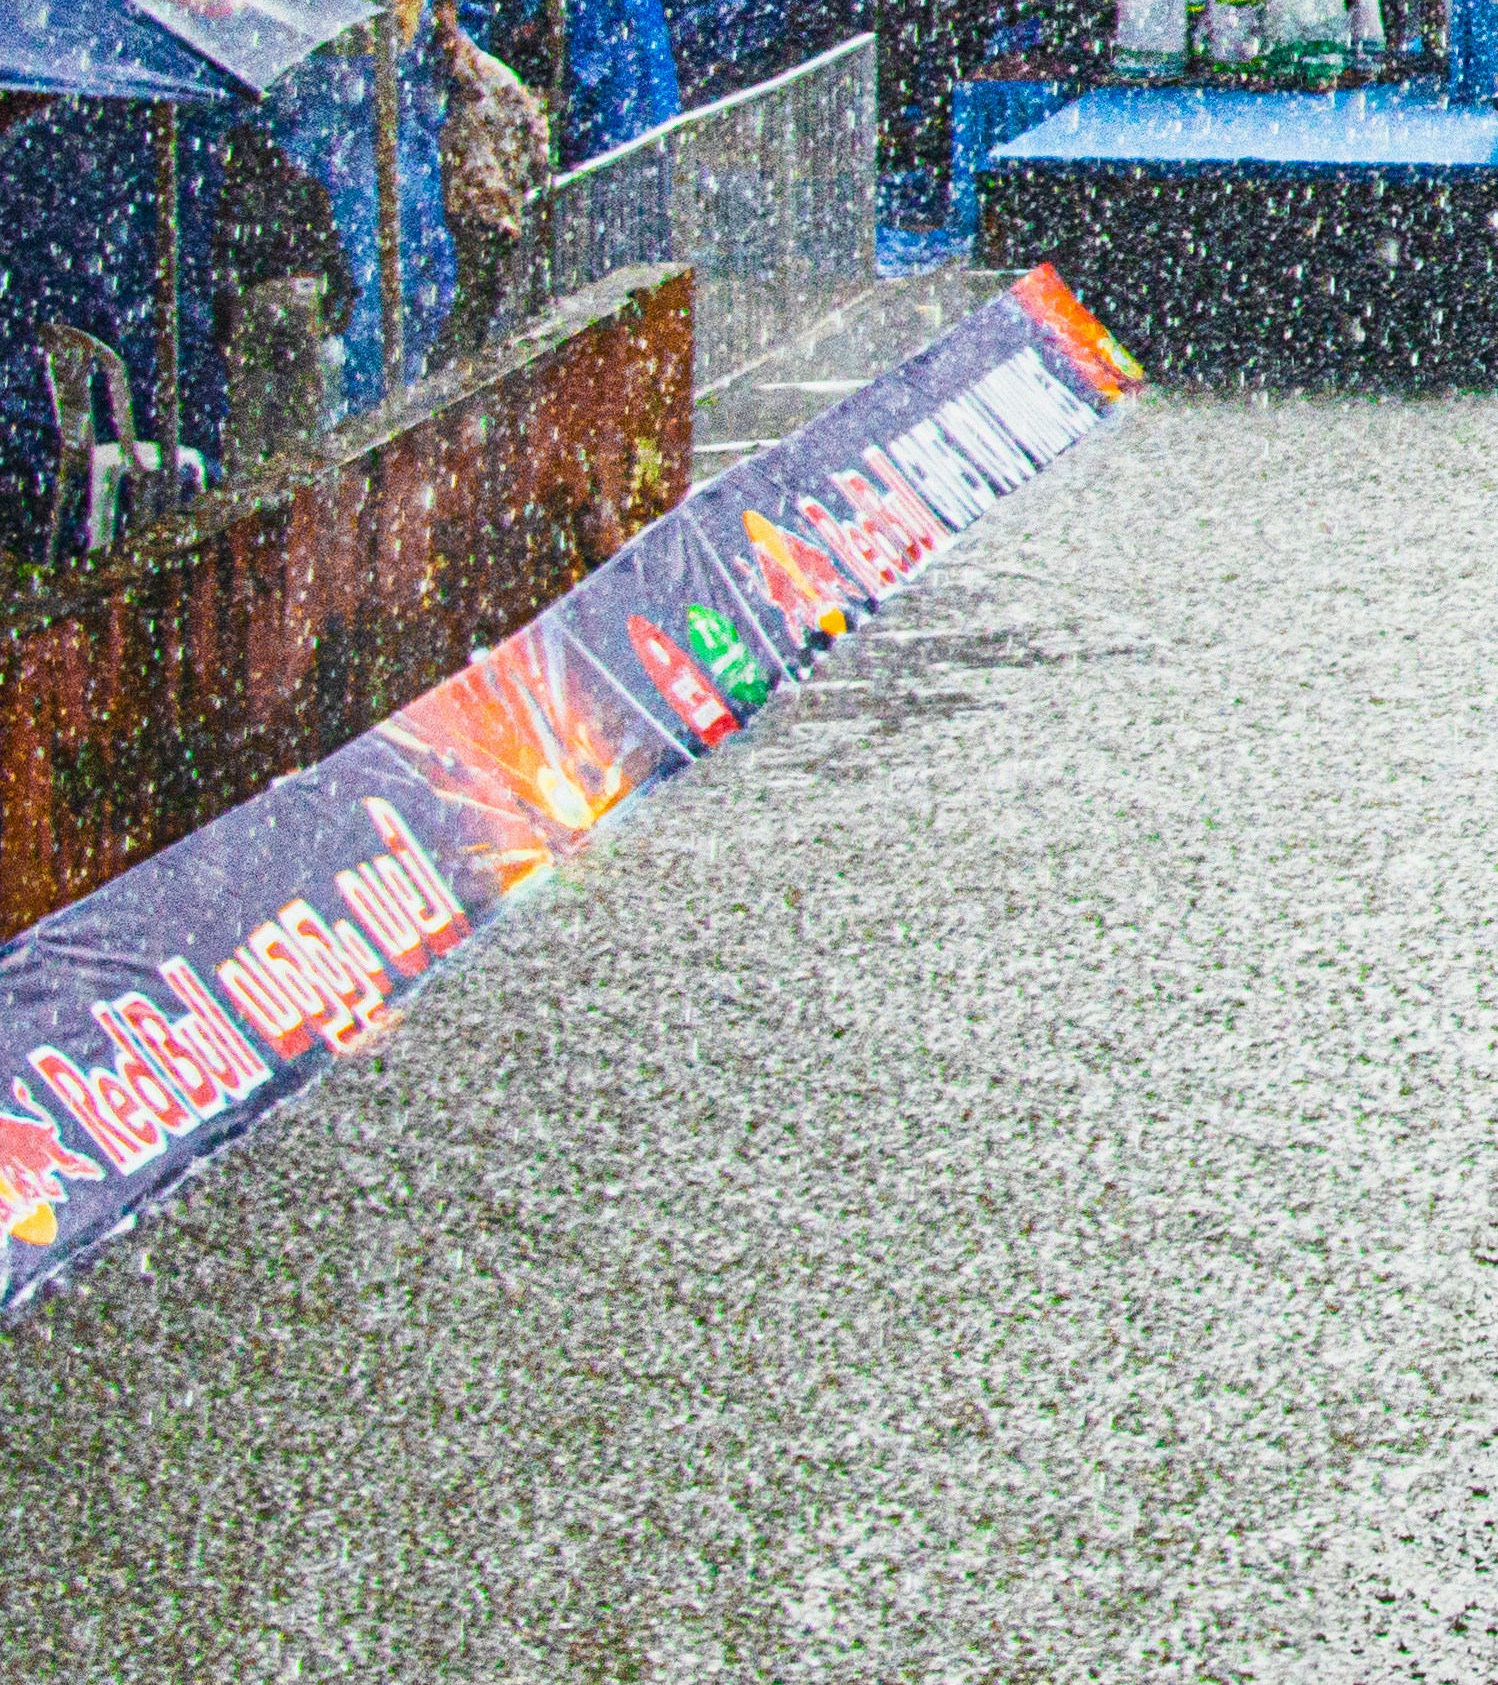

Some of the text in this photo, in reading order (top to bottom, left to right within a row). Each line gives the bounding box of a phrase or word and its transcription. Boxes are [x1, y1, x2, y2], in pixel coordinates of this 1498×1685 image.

[799, 346, 1100, 600] Red Bull GIVES YOU WINGS
[27, 955, 275, 1176] Red Bull
